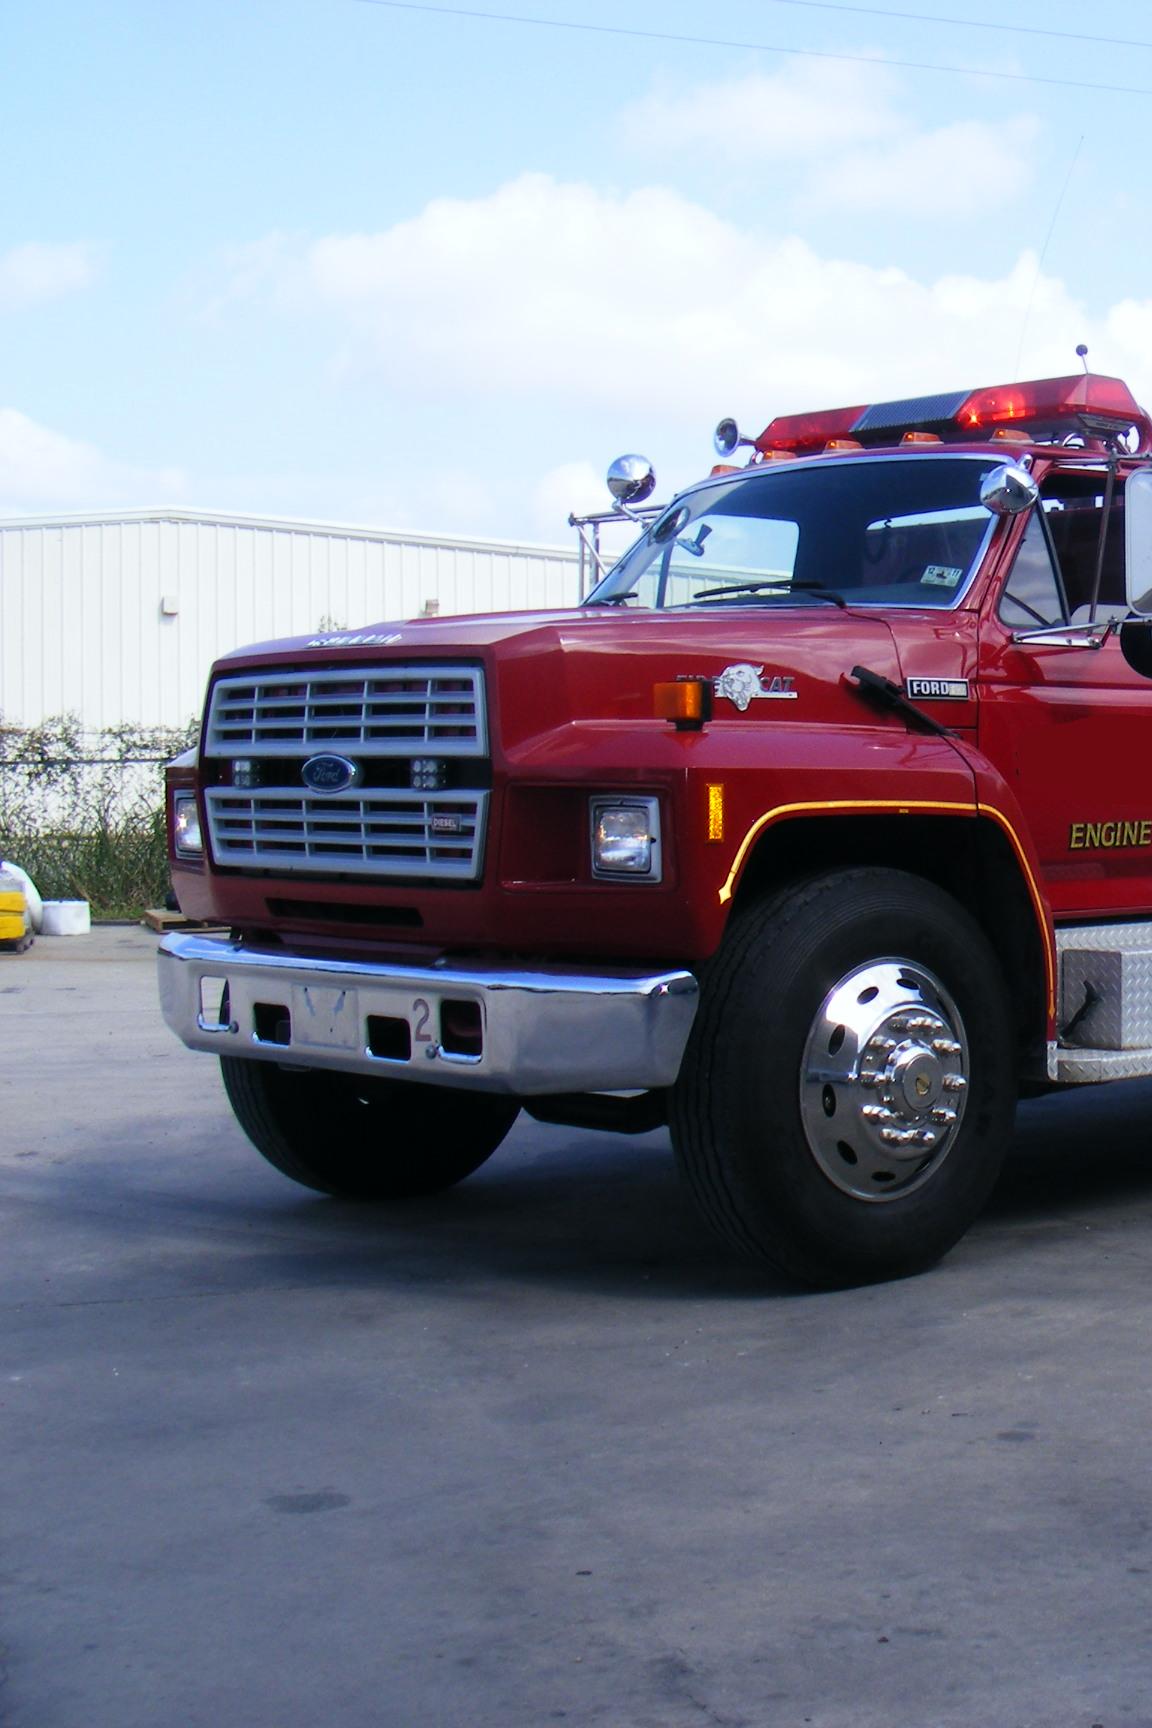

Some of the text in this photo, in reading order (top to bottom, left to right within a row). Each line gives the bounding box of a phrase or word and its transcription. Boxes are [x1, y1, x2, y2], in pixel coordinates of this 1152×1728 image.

[760, 676, 795, 692] CAT
[912, 681, 950, 695] FORD
[1070, 820, 1152, 849] ENGINE
[412, 998, 433, 1042] 2
